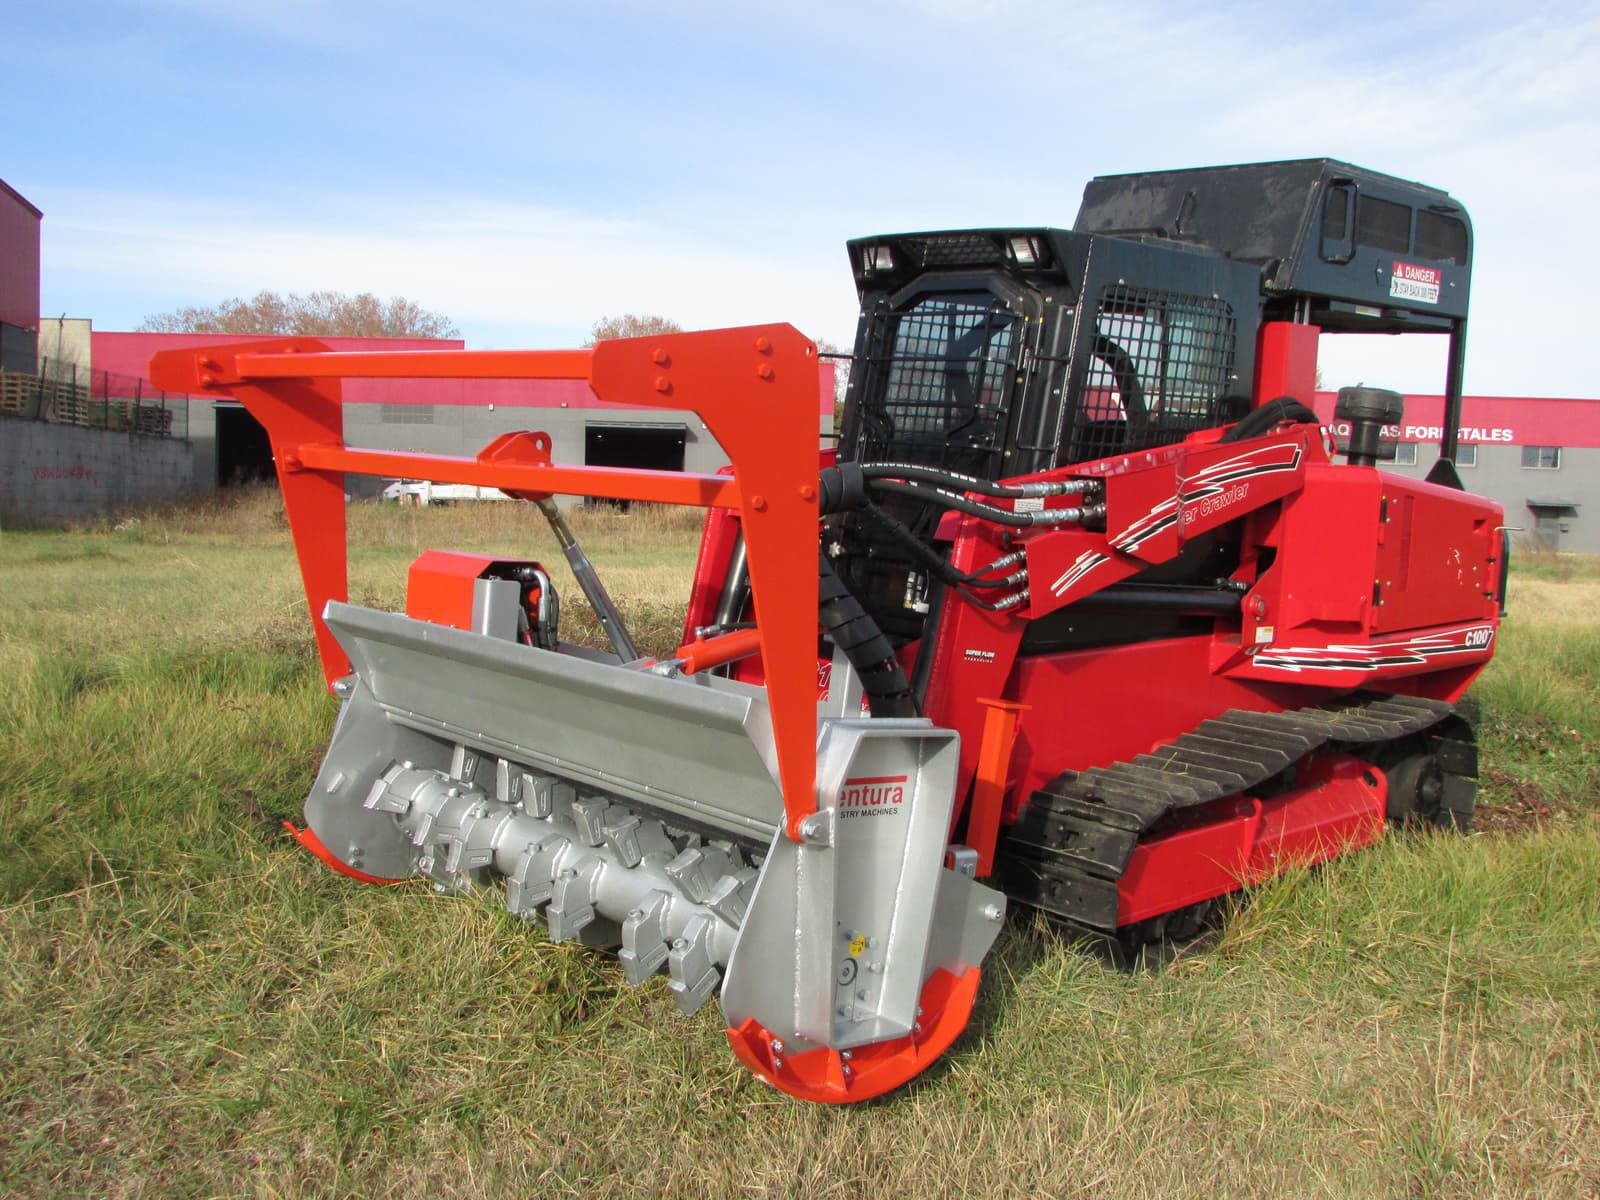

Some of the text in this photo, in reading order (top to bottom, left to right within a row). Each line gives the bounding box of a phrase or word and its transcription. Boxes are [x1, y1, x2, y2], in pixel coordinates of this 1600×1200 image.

[1405, 266, 1435, 283] DANGER
[1405, 425, 1513, 441] FORTALES
[1200, 483, 1249, 517] Crawler
[1465, 629, 1488, 646] C100
[839, 785, 904, 808] entura
[840, 807, 898, 819] STRY MACHINES
